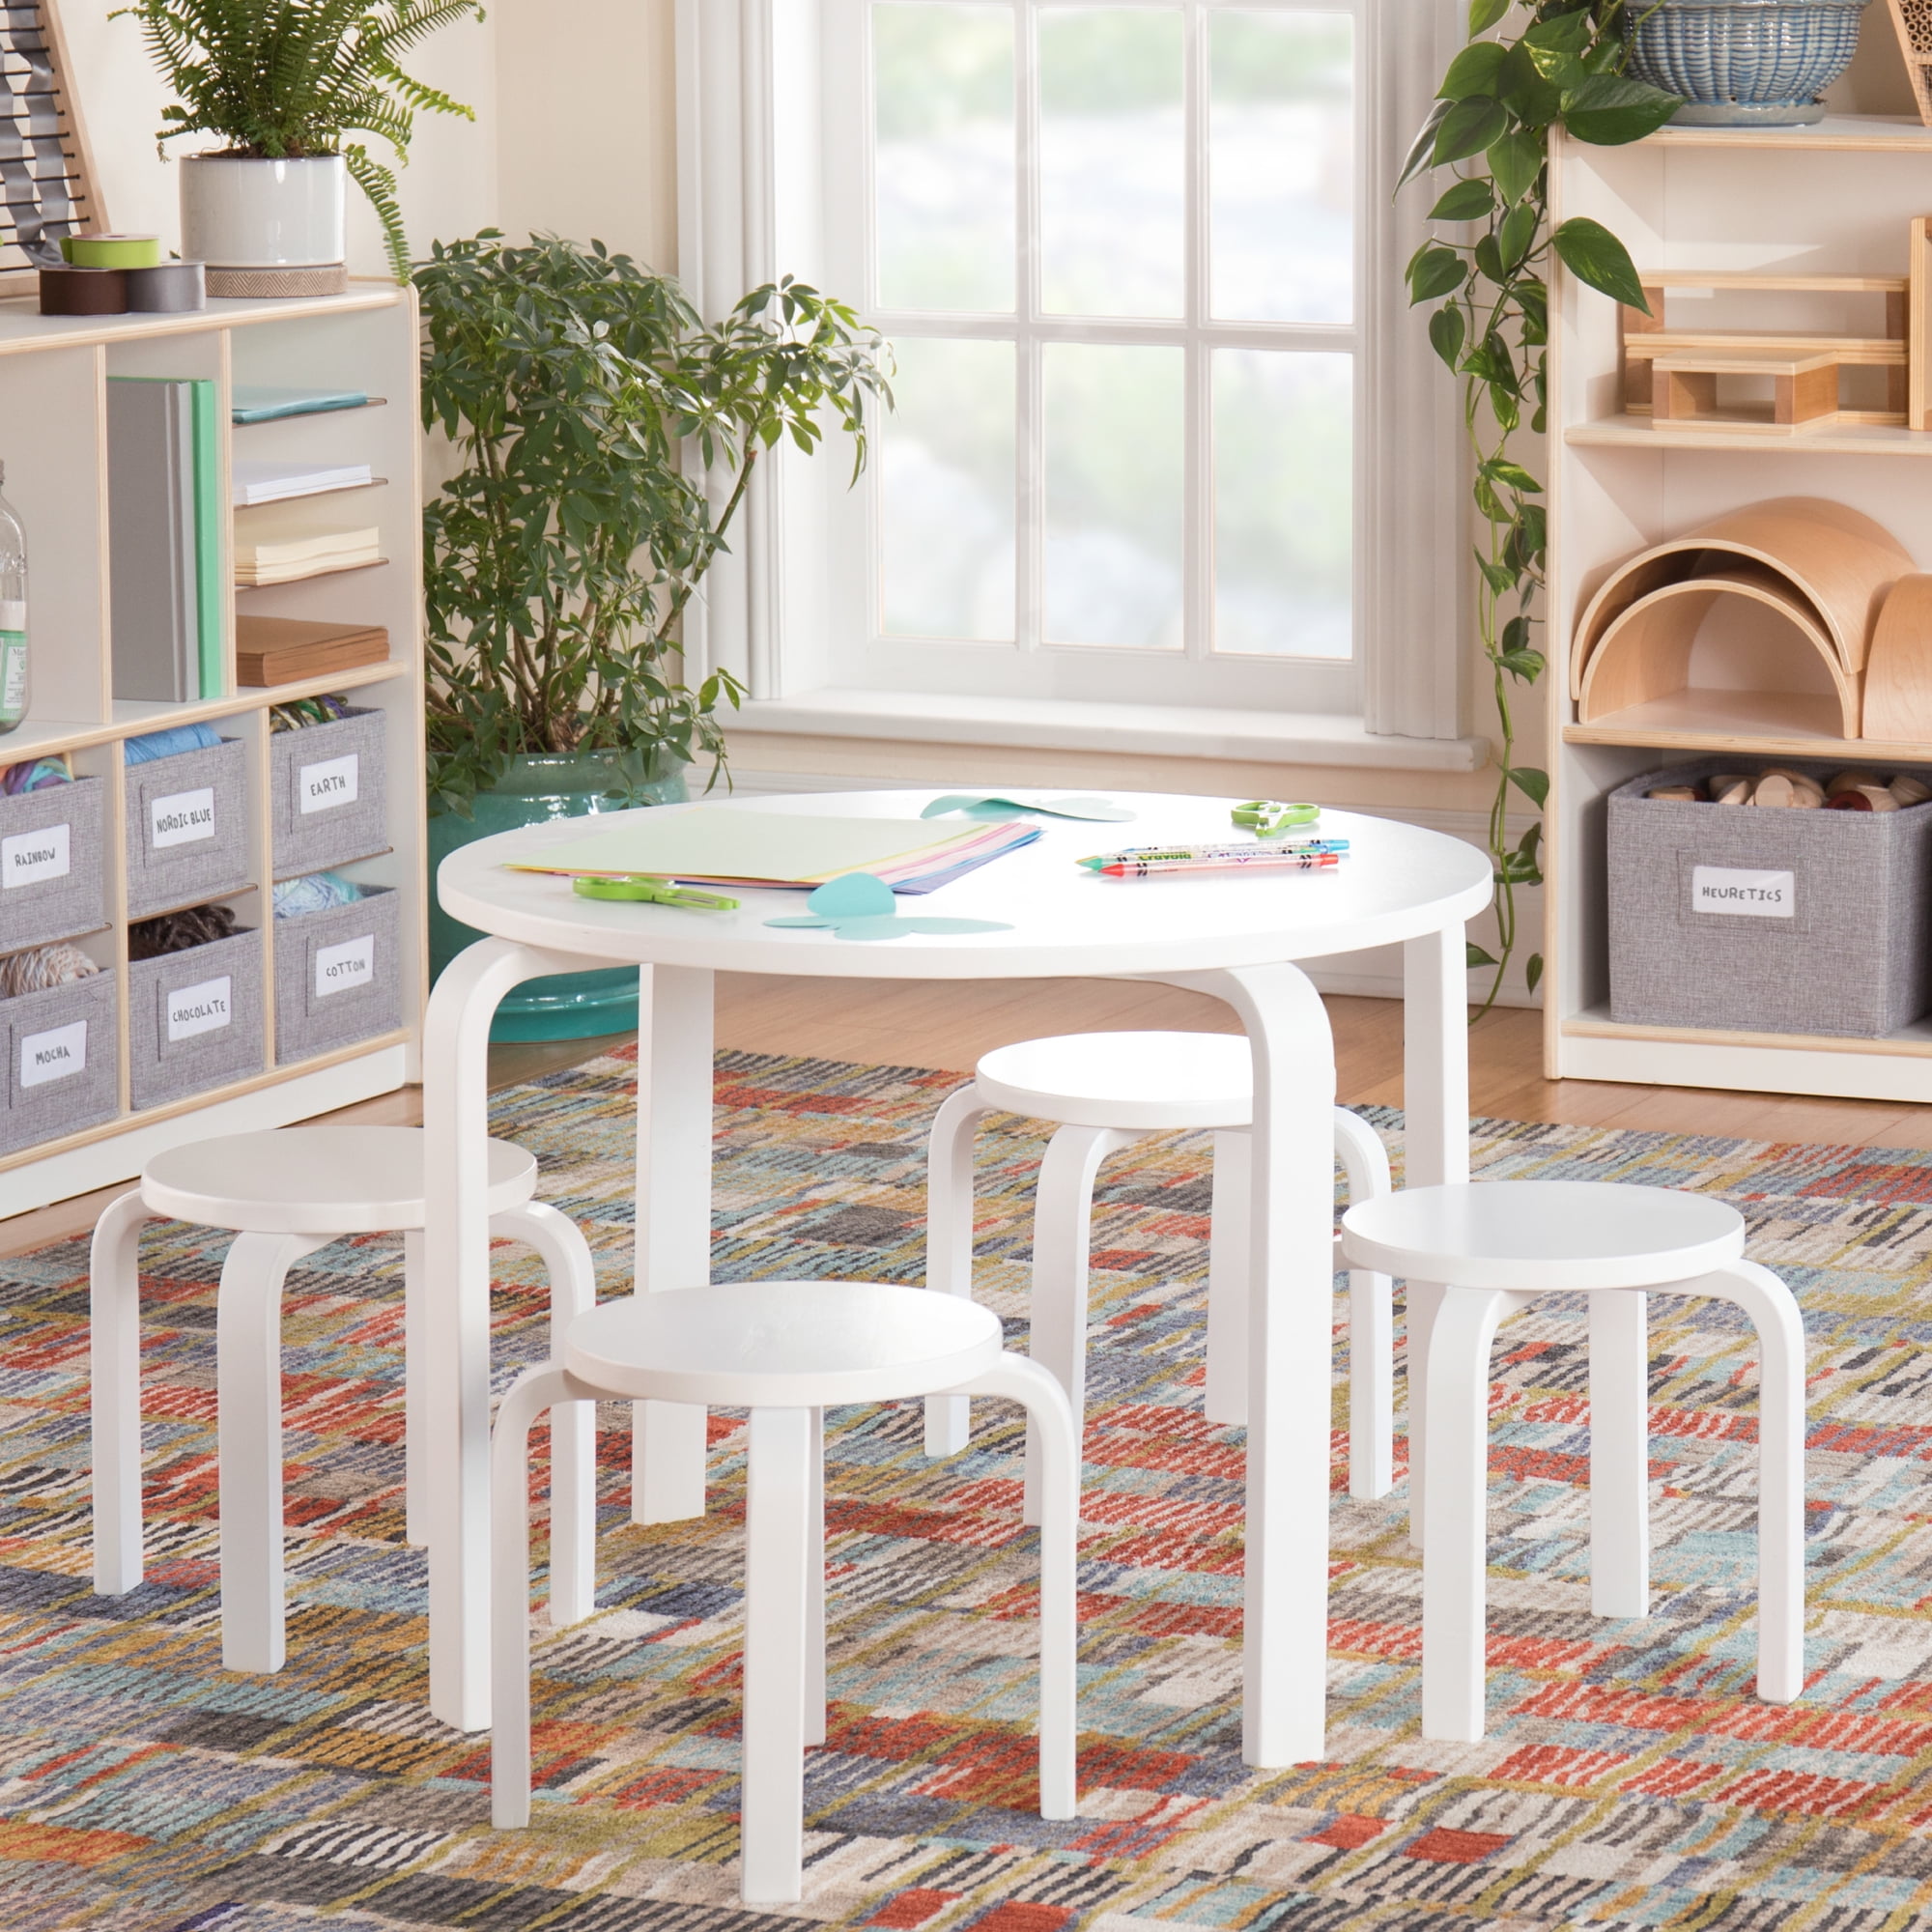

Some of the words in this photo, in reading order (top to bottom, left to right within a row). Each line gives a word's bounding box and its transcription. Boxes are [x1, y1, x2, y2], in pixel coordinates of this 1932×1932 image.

[310, 775, 346, 796] EARTH
[156, 812, 188, 834] NORDIC
[189, 808, 212, 825] BLUE
[14, 846, 56, 867] RAINBOW
[1702, 886, 1782, 902] HEURETICS
[326, 958, 365, 977] COTTON
[173, 999, 226, 1022] CHOCOLATE
[35, 1045, 71, 1065] MOCHA
